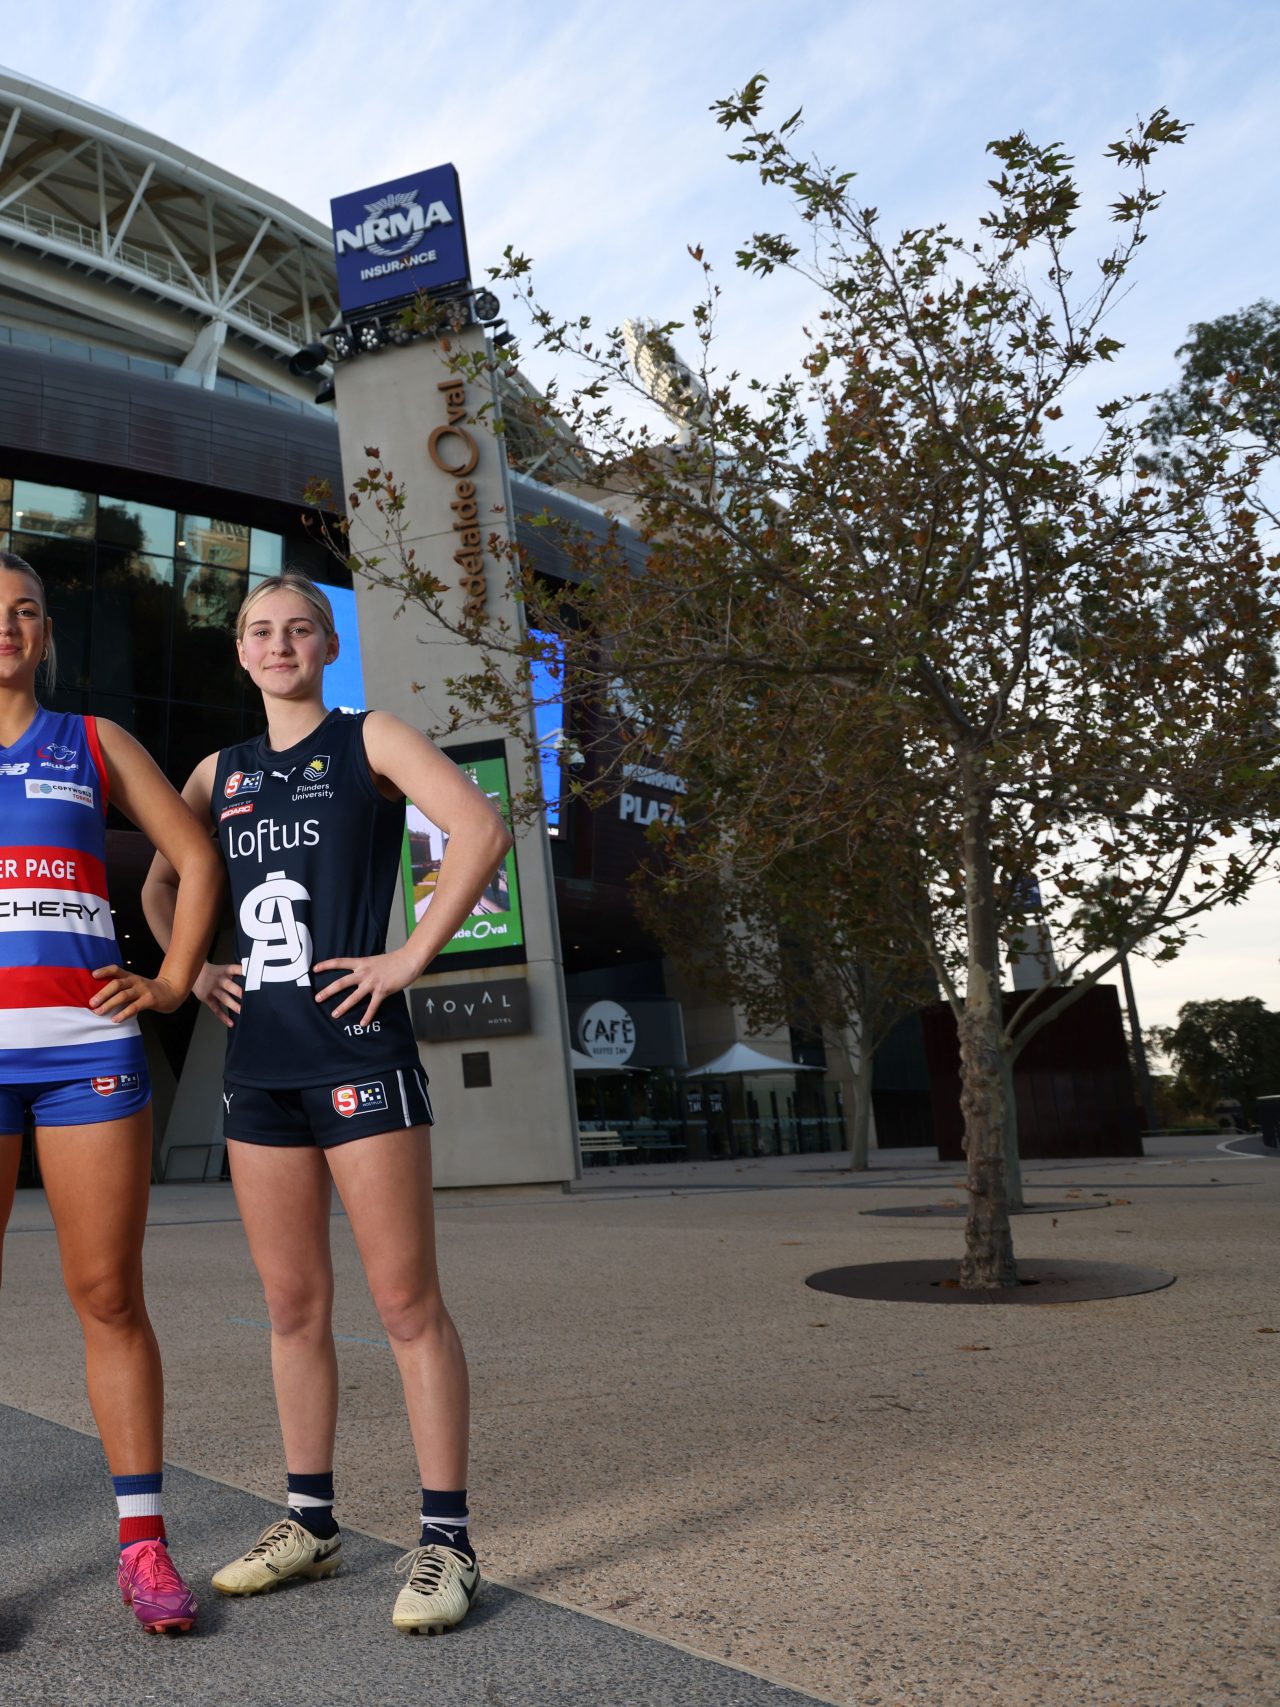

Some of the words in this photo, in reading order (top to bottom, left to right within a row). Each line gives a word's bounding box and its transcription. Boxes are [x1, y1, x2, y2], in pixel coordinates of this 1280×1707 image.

[336, 200, 453, 254] NRMA
[361, 250, 437, 281] INSURANCE
[427, 380, 480, 478] Oval
[52, 785, 92, 798] COPYWORLD
[292, 789, 334, 802] University
[296, 783, 330, 793] Flinders
[228, 818, 320, 863] loftus
[25, 858, 76, 881] PAGE
